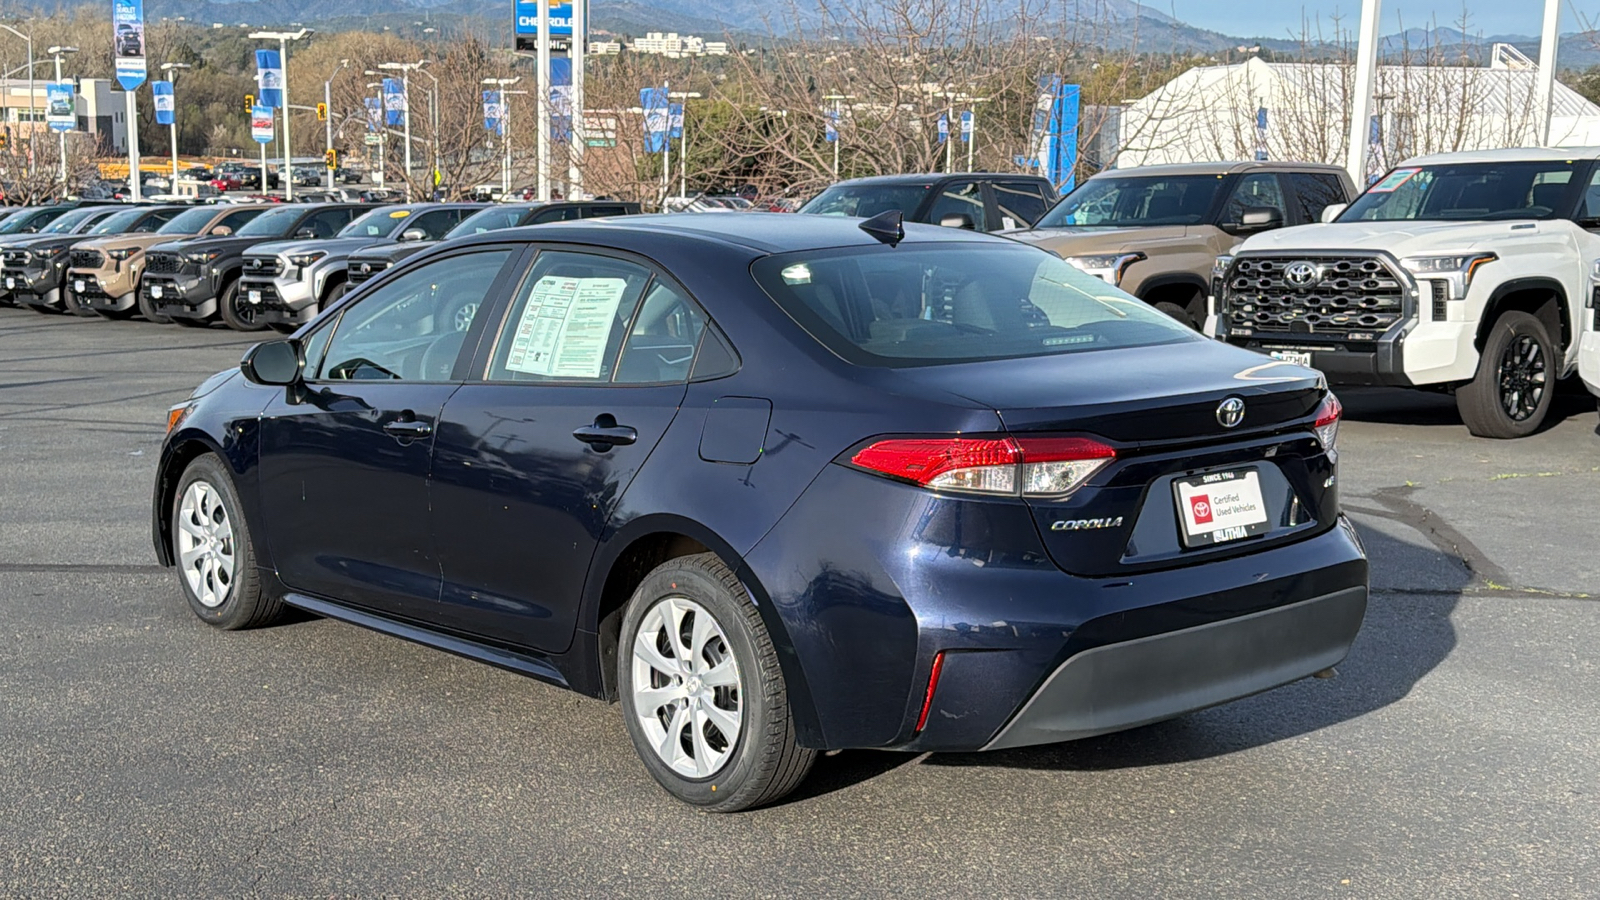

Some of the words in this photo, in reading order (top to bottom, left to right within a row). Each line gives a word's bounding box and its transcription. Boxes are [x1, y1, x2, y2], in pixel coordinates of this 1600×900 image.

[519, 16, 574, 27] CHEROLE
[1203, 473, 1222, 483] SINCE
[1213, 493, 1240, 505] Certified
[1216, 507, 1232, 517] Used
[1232, 502, 1257, 514] Vehicles
[1051, 516, 1123, 531] COROLLA
[1220, 525, 1248, 541] LITHIA
